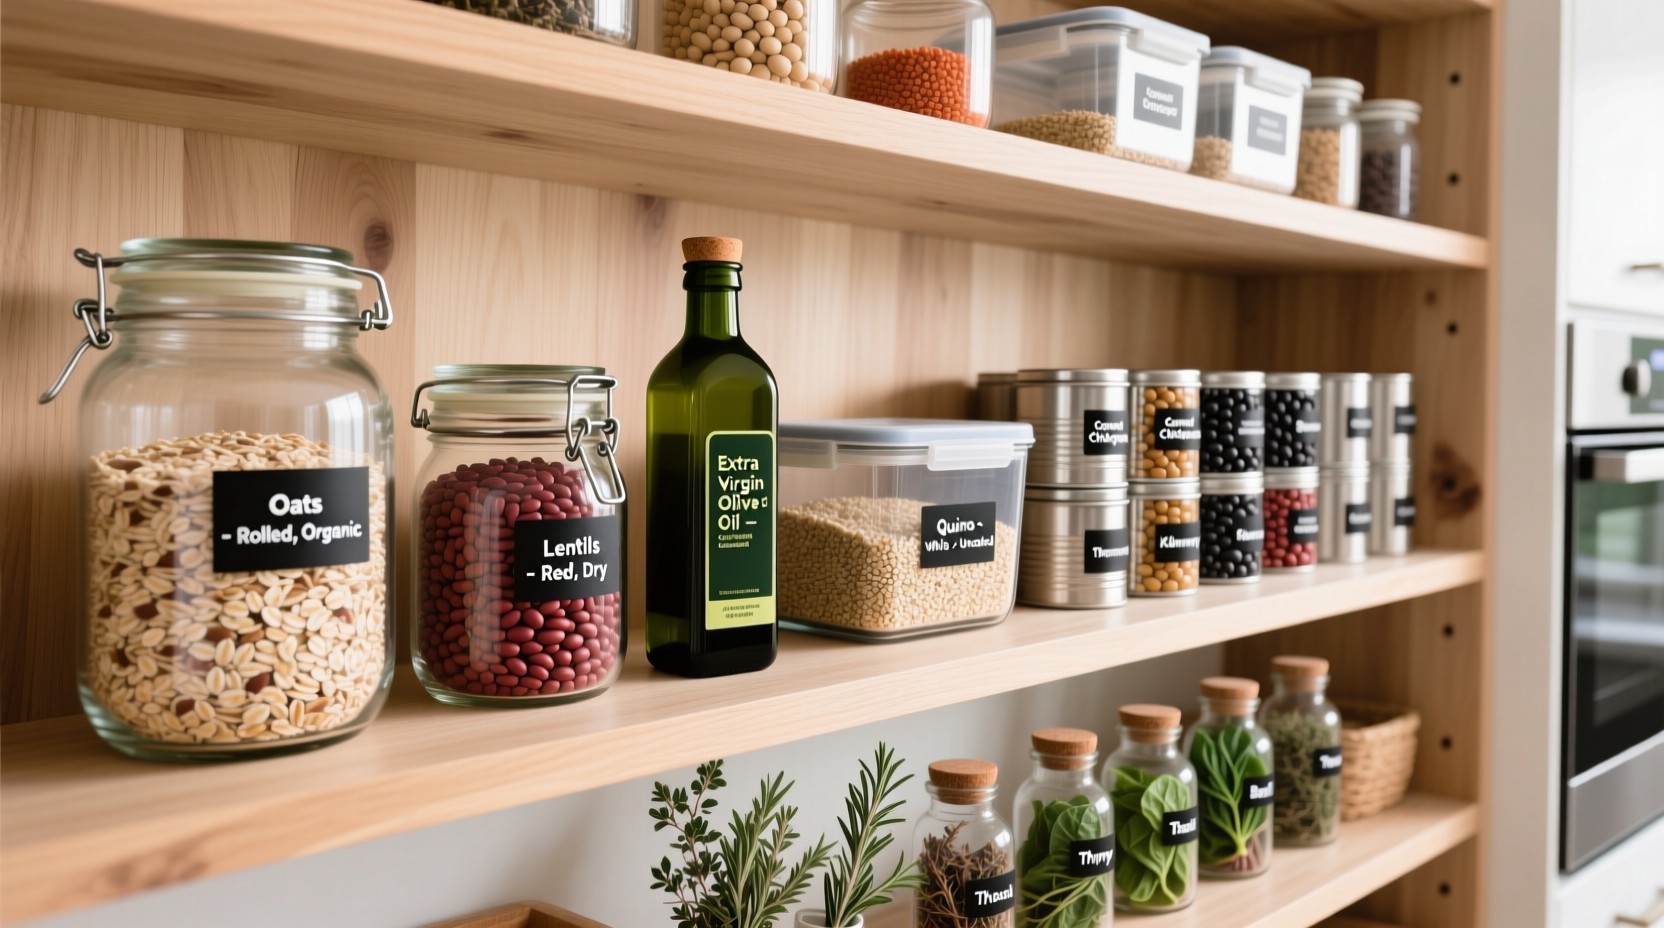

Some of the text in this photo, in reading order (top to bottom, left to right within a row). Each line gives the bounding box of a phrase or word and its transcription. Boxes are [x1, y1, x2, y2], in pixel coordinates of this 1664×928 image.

[718, 454, 759, 472] Extra
[718, 475, 764, 494] Virgin
[268, 493, 323, 516] Oats
[718, 494, 760, 511] Olive
[718, 514, 740, 531] Oil
[236, 524, 298, 546] Rolled,
[301, 520, 362, 544] Organic
[544, 536, 600, 558] Lentils
[542, 562, 578, 581] Red,
[582, 562, 608, 582] Dry
